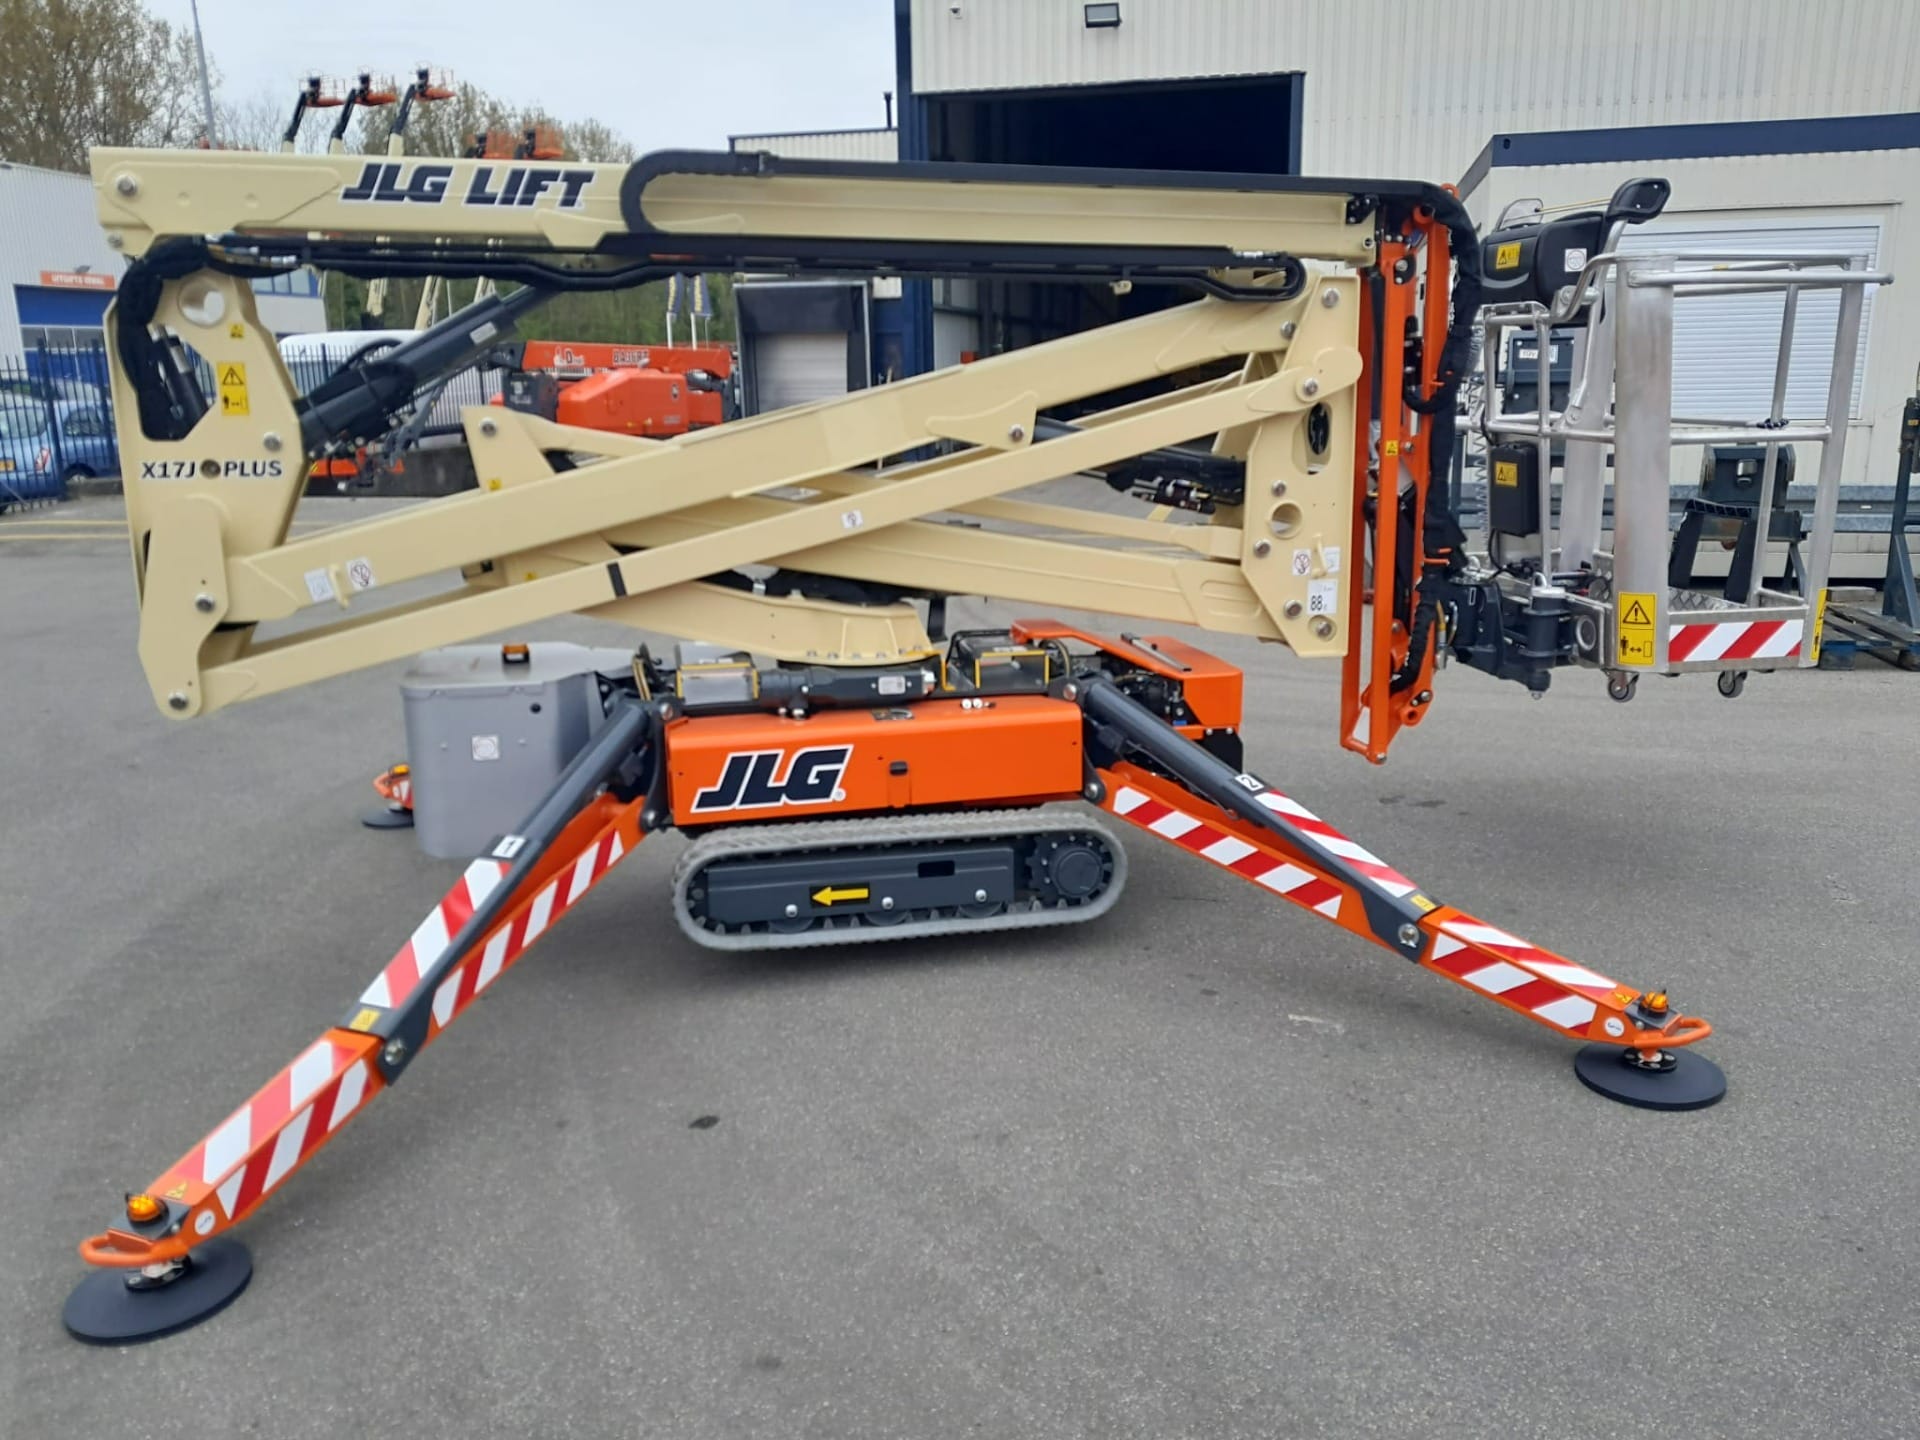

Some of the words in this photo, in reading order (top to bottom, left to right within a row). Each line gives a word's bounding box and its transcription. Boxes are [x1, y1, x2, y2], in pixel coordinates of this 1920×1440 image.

[341, 162, 454, 203] JLG
[464, 166, 596, 207] LIFT
[141, 460, 196, 479] X17J
[223, 460, 283, 478] PLUS
[1310, 594, 1323, 612] 88
[692, 746, 853, 811] JLG
[1240, 776, 1260, 789] 2
